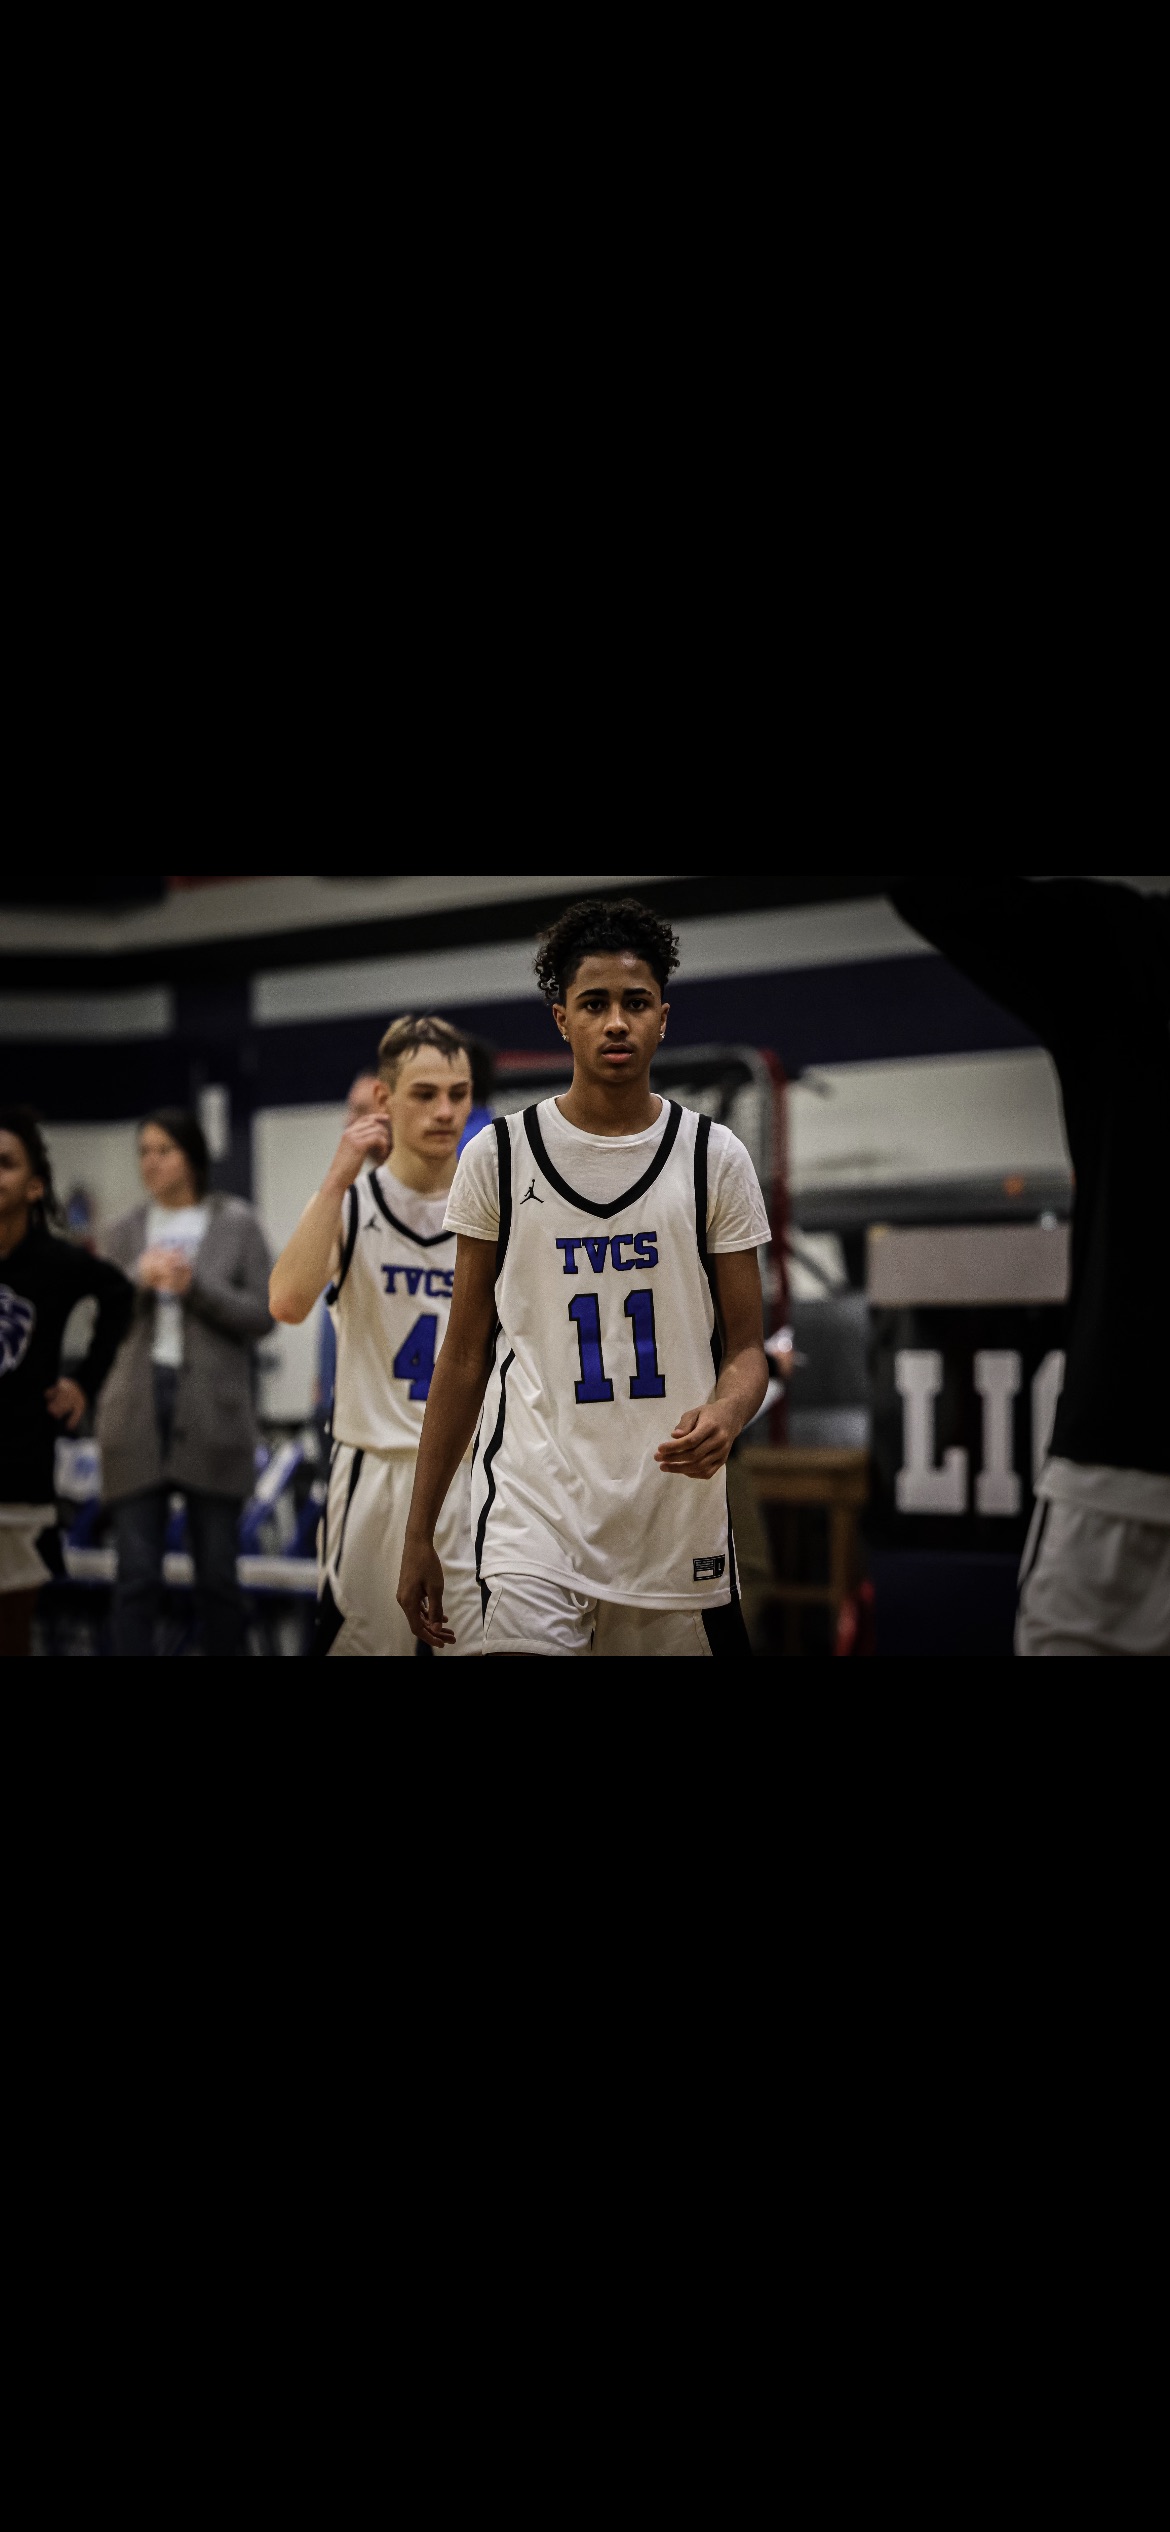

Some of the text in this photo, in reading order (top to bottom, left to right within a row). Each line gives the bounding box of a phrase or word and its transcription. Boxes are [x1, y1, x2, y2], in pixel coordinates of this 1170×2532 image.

[555, 1231, 659, 1274] TVCS
[393, 1314, 438, 1401] 4
[568, 1289, 666, 1404] 11
